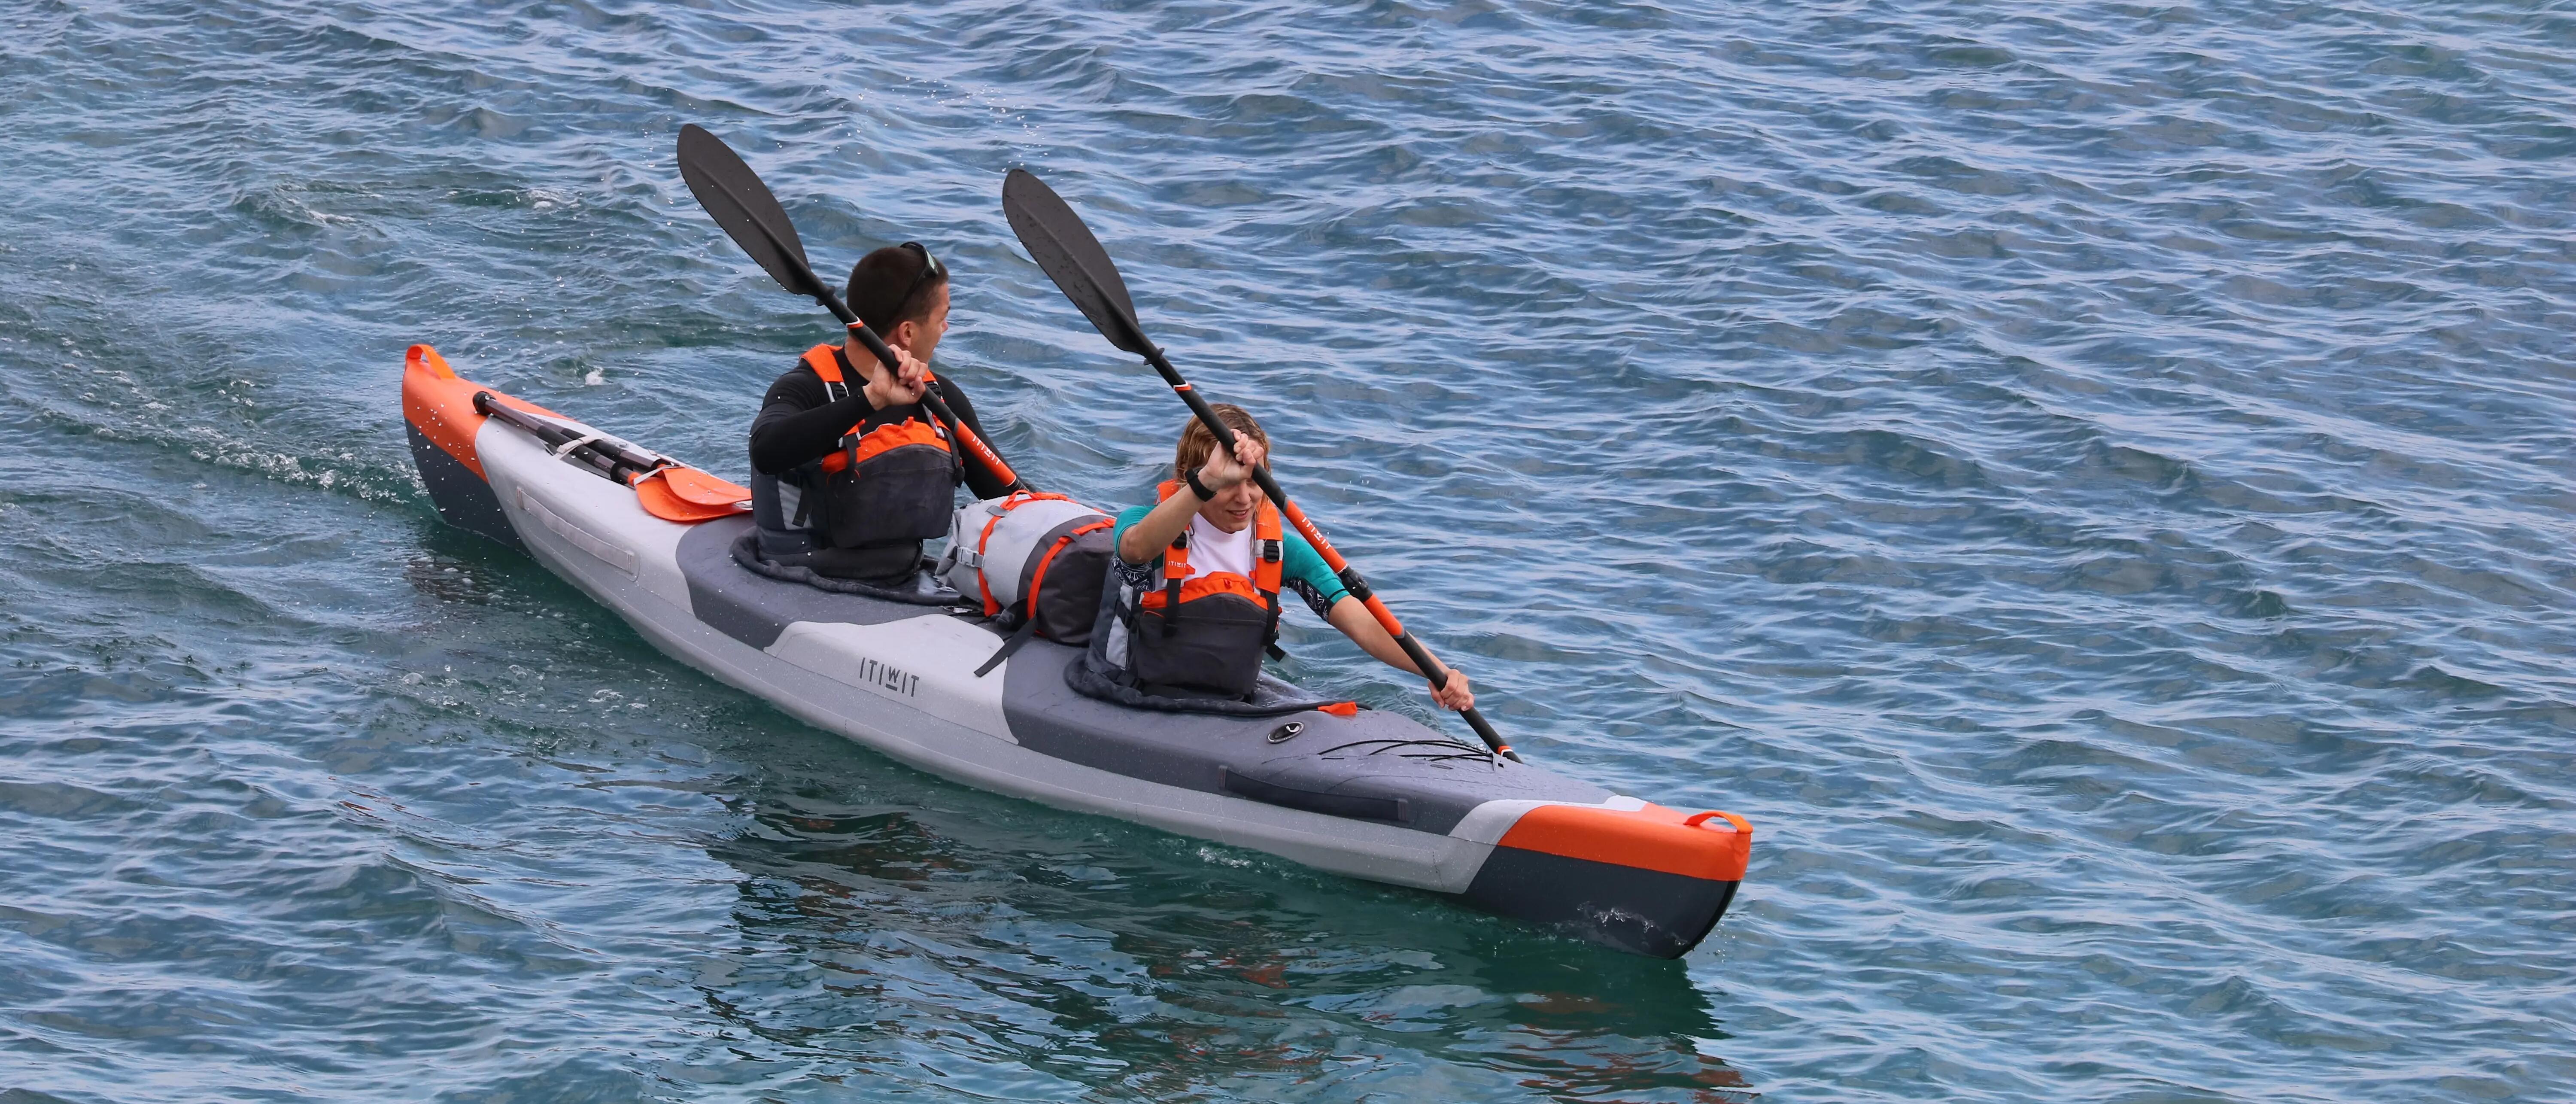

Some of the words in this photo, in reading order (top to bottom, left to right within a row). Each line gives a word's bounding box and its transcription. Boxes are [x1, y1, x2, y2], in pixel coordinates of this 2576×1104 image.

[972, 435, 1001, 465] ITIWIT
[1302, 517, 1332, 550] ITIWIT
[860, 657, 920, 697] ITIWIT
